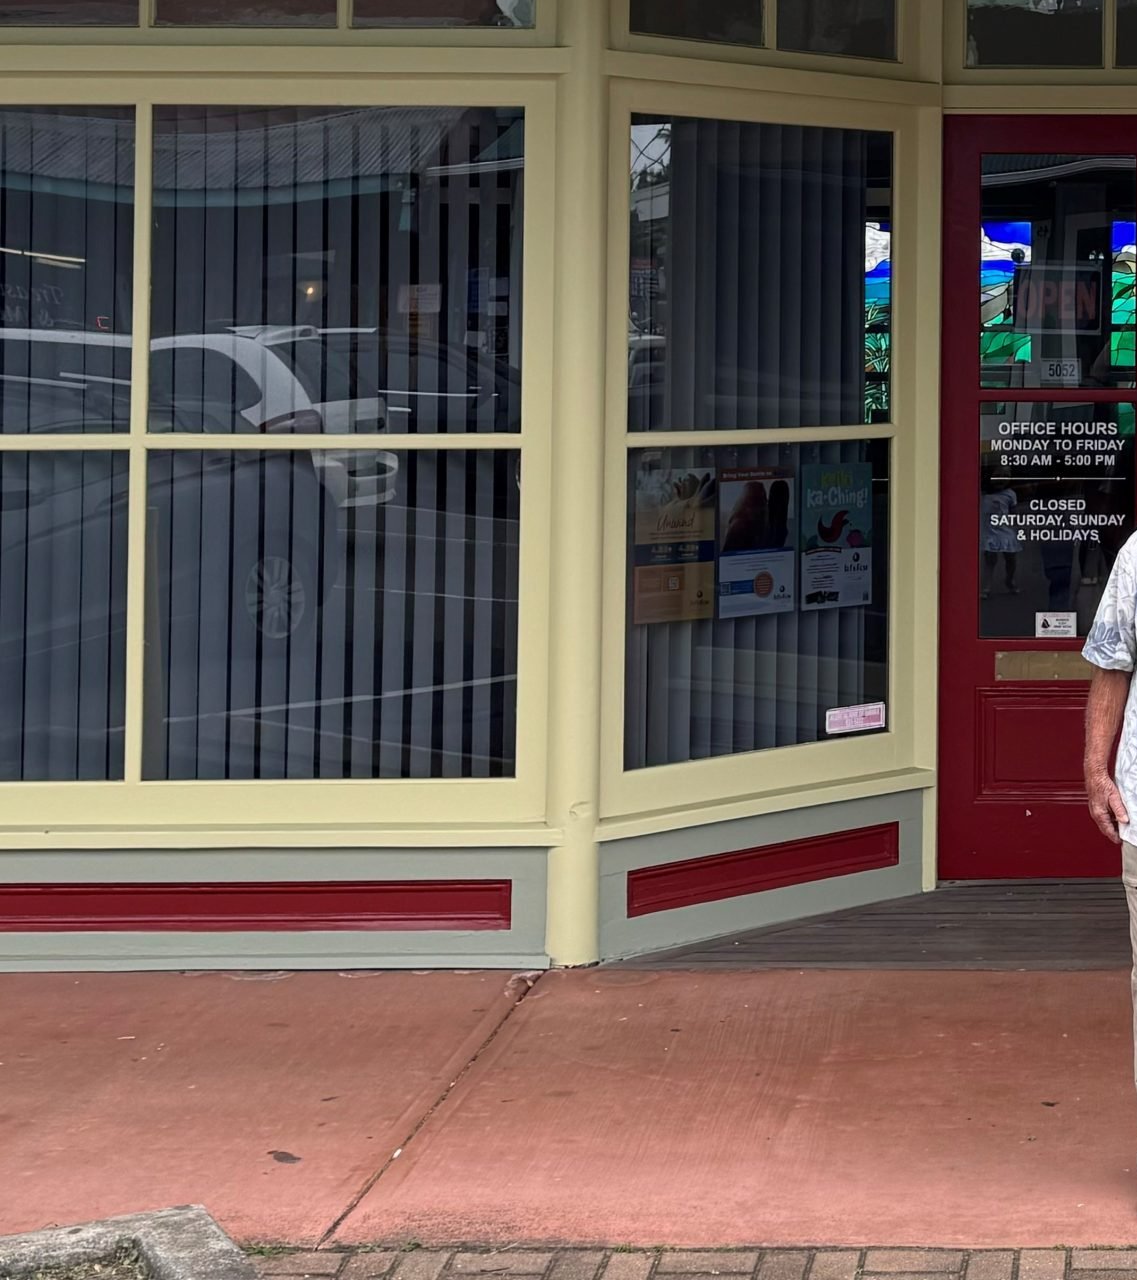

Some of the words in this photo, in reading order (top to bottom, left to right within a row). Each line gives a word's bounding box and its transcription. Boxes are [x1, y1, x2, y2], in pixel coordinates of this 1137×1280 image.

[1016, 280, 1098, 320] OPEN
[1048, 363, 1076, 377] 5052
[998, 422, 1056, 435] OFFICE
[1061, 422, 1118, 435] HOURS
[991, 439, 1050, 451] MONDAY
[1053, 439, 1072, 451] TO
[1076, 439, 1125, 451] FRIDAY
[1000, 454, 1028, 466] 8:30
[1031, 454, 1052, 466] AM
[1064, 454, 1091, 466] 5:00
[1095, 454, 1115, 466] PM
[1029, 499, 1086, 511] CLOSED
[990, 514, 1066, 528] SATURDAY,
[1069, 514, 1126, 526] SUNDAY
[1016, 529, 1027, 541] &
[1030, 529, 1099, 541] HOLIDAYS
